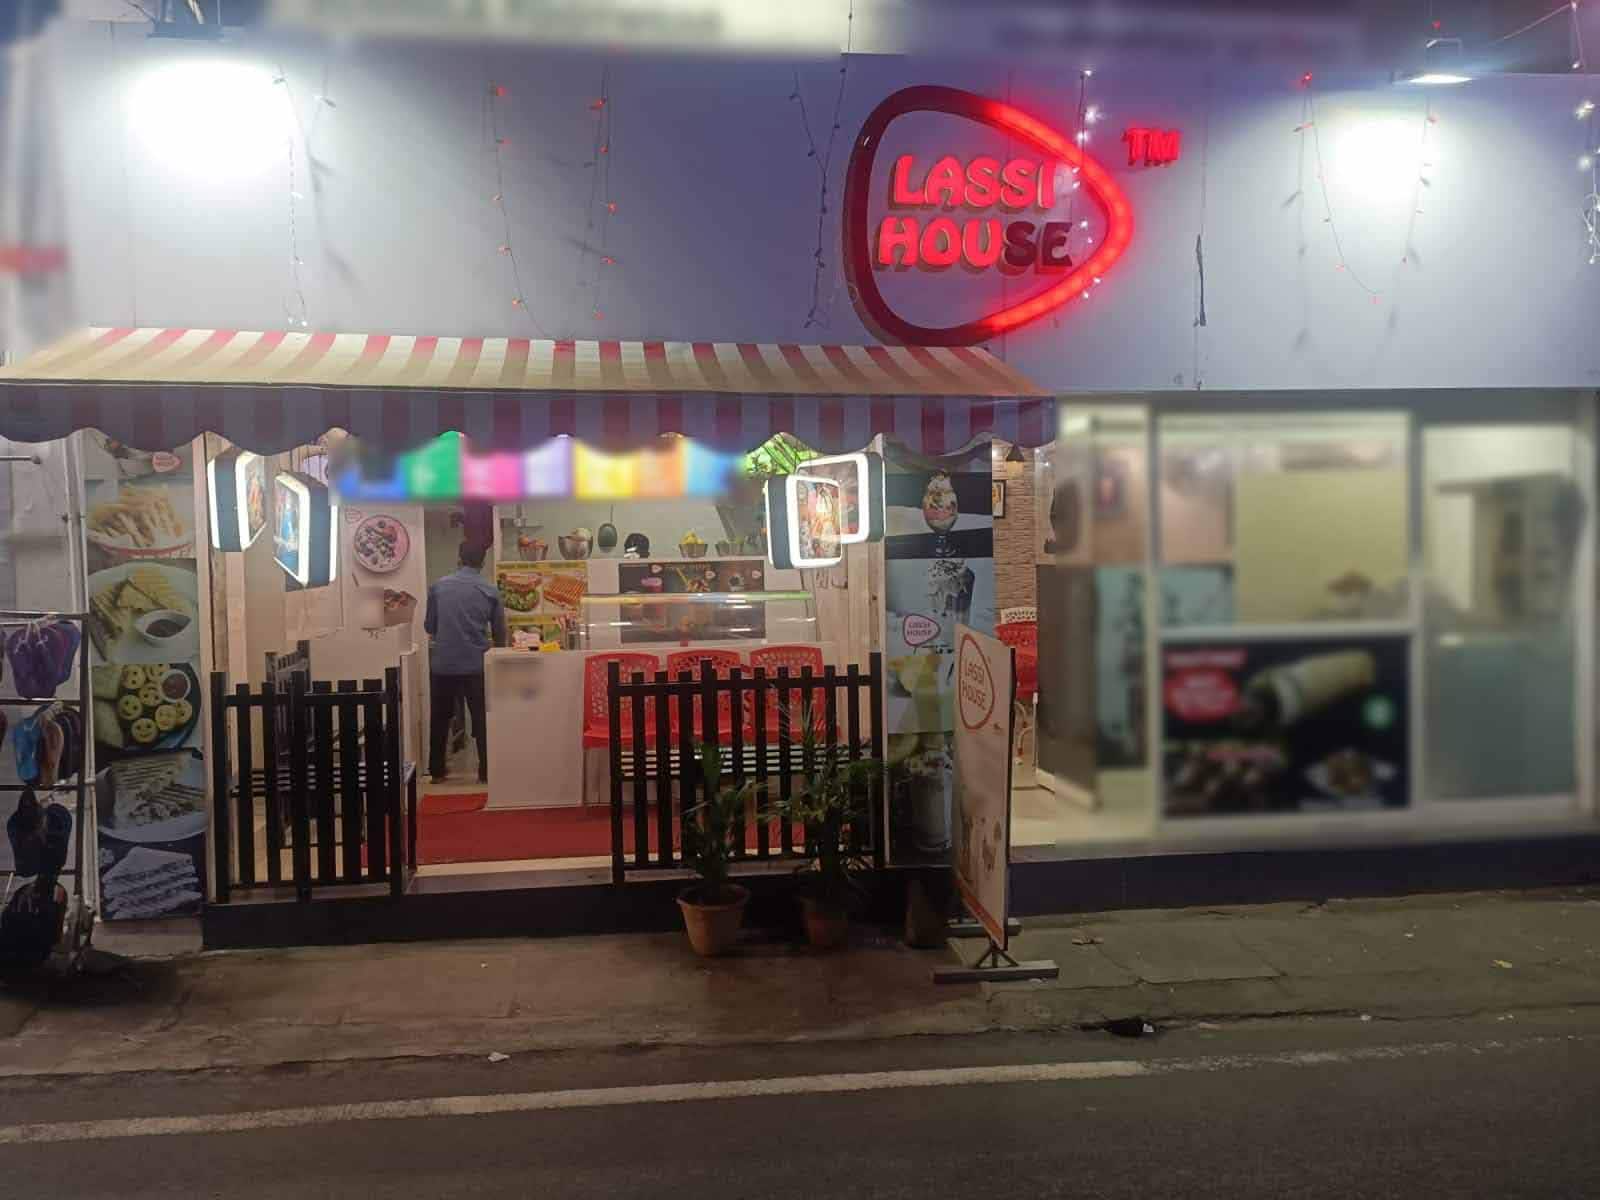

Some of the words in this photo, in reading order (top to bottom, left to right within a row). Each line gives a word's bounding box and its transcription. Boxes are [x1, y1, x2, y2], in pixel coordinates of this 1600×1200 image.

[891, 155, 1057, 209] LASSI
[877, 216, 1074, 271] HOUSE
[964, 658, 985, 688] LASSI
[961, 679, 987, 711] HOUSE
